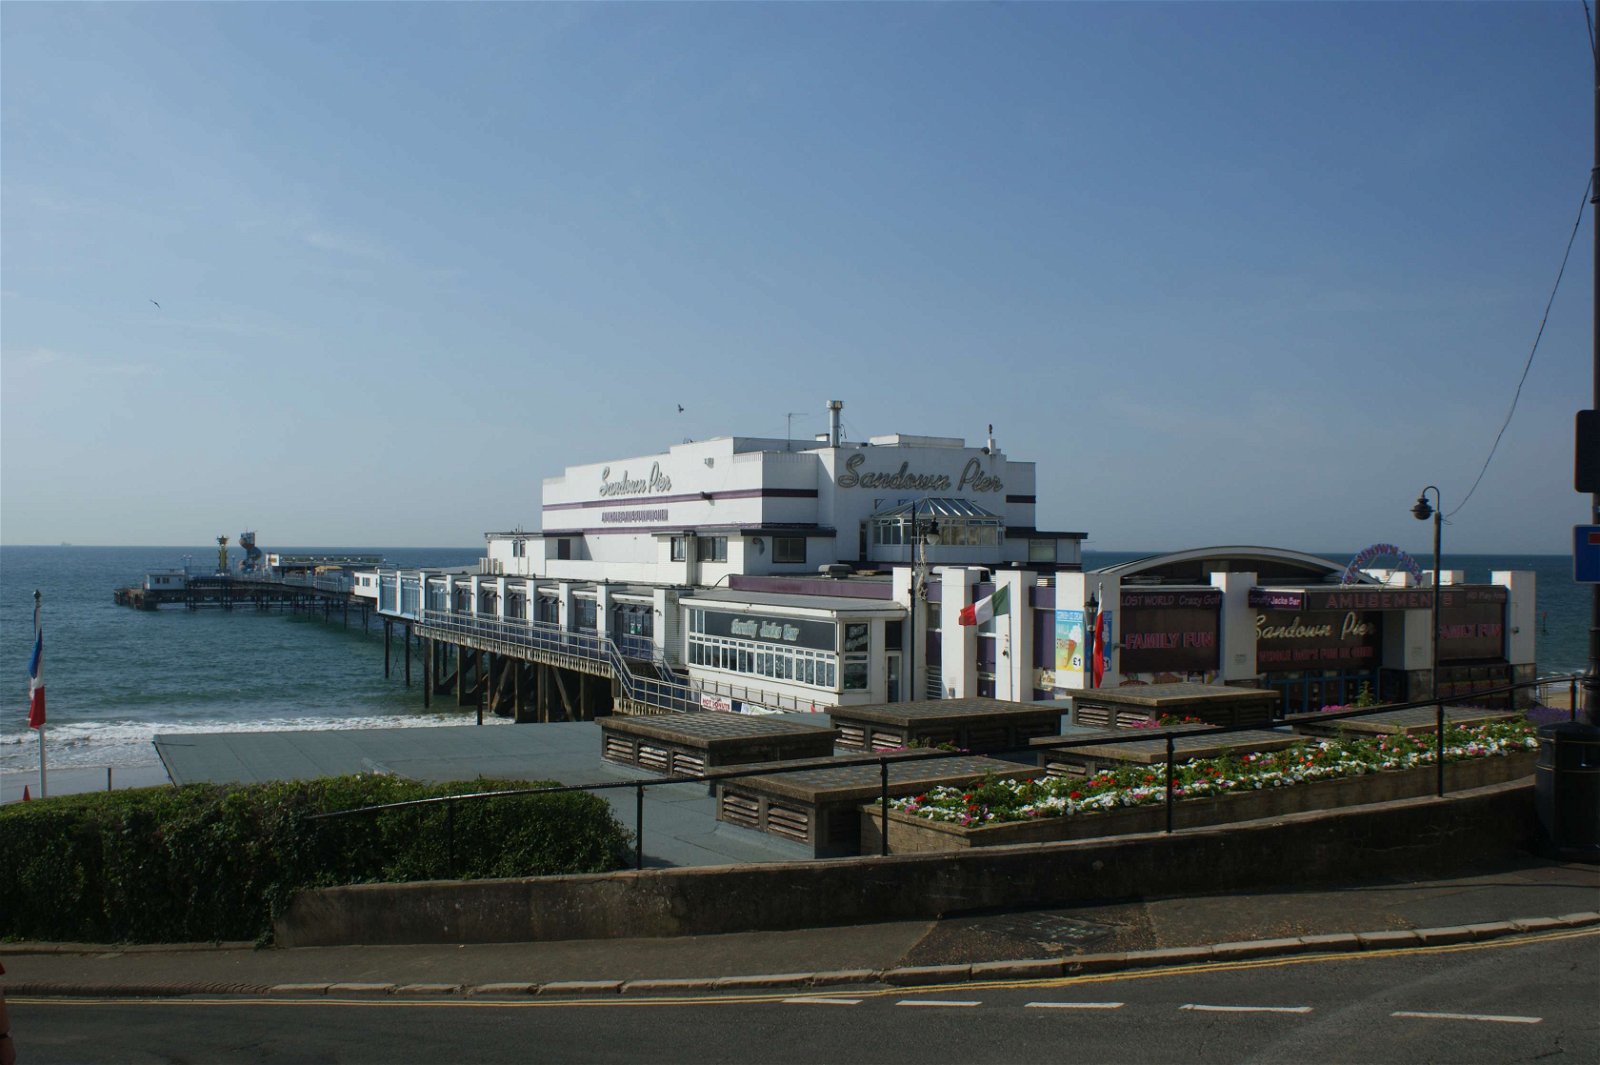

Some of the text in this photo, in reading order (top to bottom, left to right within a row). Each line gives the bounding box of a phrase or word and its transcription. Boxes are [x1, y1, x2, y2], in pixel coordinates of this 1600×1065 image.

[599, 461, 672, 497] Sandown Pier
[838, 453, 1003, 492] Sandown Pier
[1144, 594, 1175, 606] WORLD
[1325, 592, 1454, 609] AMUSEMENS
[1256, 611, 1375, 641] Sandown Pier
[1125, 631, 1214, 650] FAMILY FUN
[1073, 656, 1081, 667] £1
